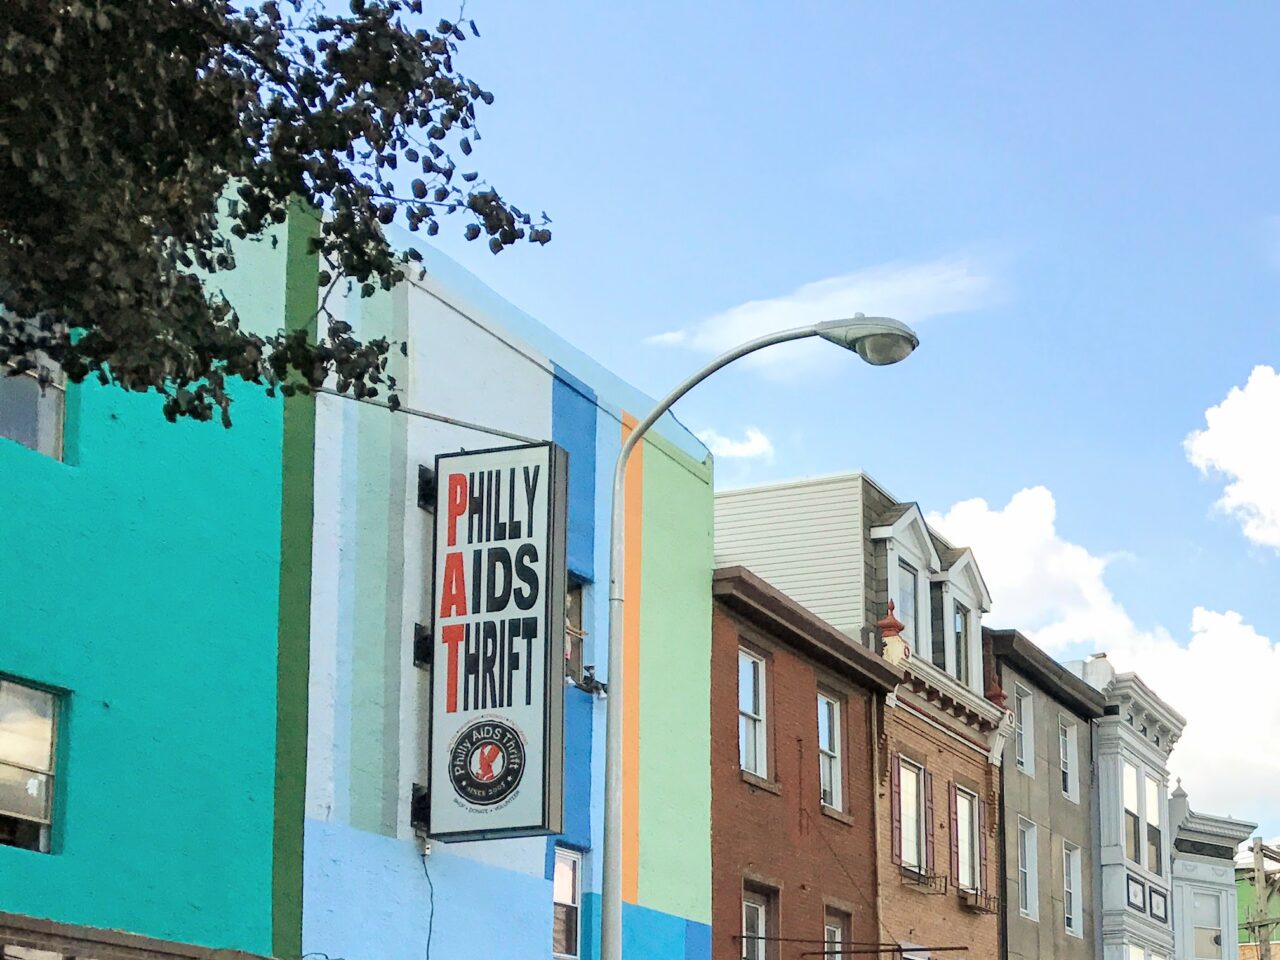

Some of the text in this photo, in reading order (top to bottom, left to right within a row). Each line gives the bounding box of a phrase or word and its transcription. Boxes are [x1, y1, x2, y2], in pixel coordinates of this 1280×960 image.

[447, 464, 541, 547] PHILLY
[440, 543, 540, 619] AIDS
[441, 616, 538, 714] THRIFT
[455, 739, 472, 776] Philly
[472, 726, 503, 742] AIDS
[502, 732, 521, 770] Thrift
